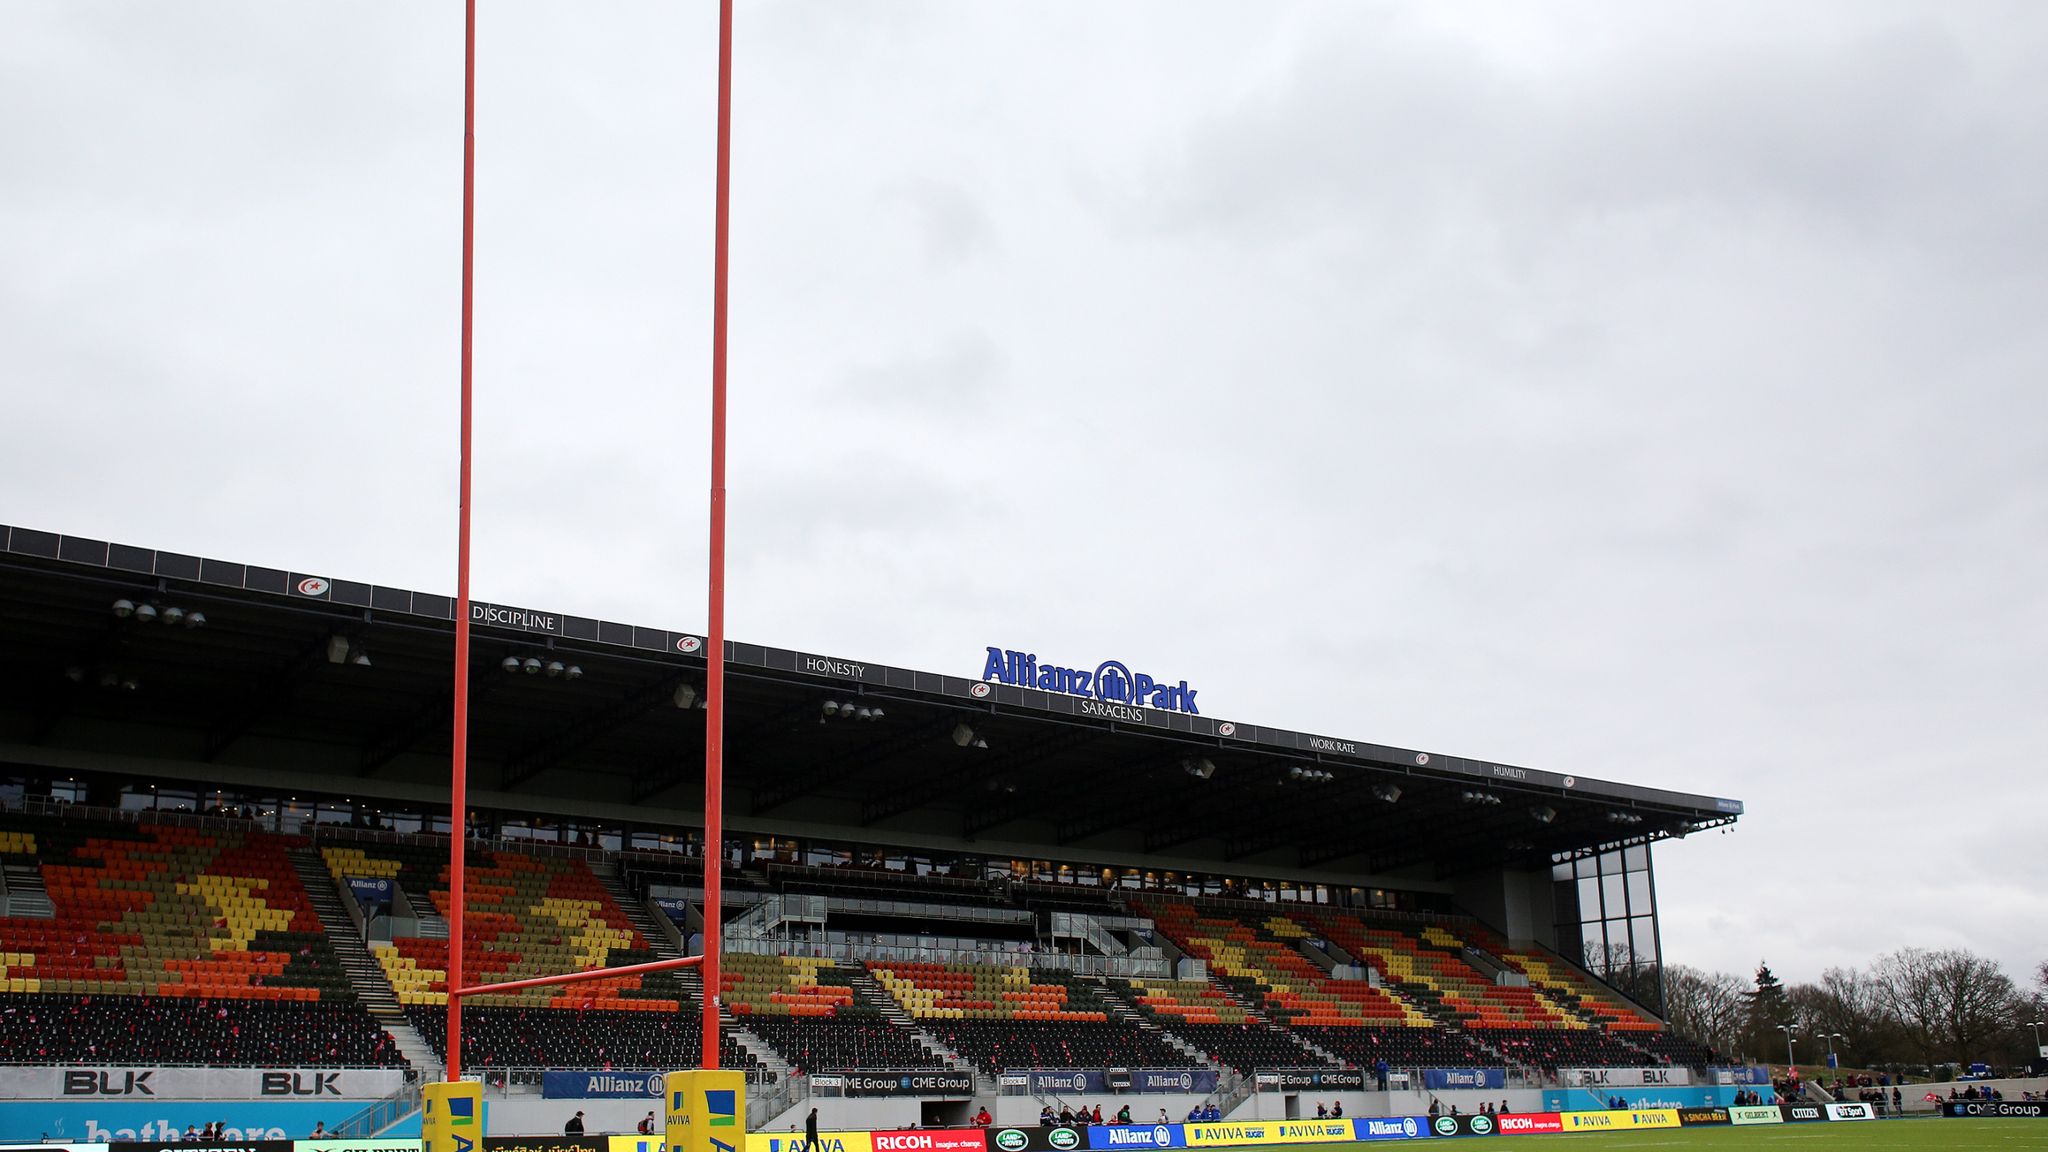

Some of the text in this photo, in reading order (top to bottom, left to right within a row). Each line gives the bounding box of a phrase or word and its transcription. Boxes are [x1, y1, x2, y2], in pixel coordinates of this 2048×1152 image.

[472, 606, 554, 630] DISCIPLINE
[806, 658, 864, 677] HONESTY
[982, 646, 1199, 714] Allianz Park
[1081, 700, 1142, 721] SARACENS
[1309, 737, 1355, 753] WORK RATE
[1493, 766, 1526, 779] HUMILITY
[351, 880, 376, 889] Allianz
[64, 1071, 154, 1095] BLK
[1037, 1076, 1072, 1088] Allianz
[1148, 1075, 1179, 1087] Allianz
[1287, 1075, 1311, 1086] Group
[1321, 1074, 1361, 1085] CME Group
[1446, 1073, 1474, 1084] Allianz
[1583, 1070, 1610, 1084] BLK
[1643, 1070, 1669, 1083] BLK
[261, 1072, 342, 1095] BLK
[587, 1076, 643, 1092] Allianz
[845, 1077, 897, 1091] ME Group
[912, 1077, 969, 1090] CME Group
[1792, 1107, 1819, 1119] CITIZEN
[1998, 1103, 2040, 1117] Group
[667, 1115, 690, 1125] AVIVA
[1500, 1118, 1533, 1129] RICOH
[1583, 1116, 1611, 1126] AVIVA
[1641, 1114, 1667, 1124] AVIVA
[1205, 1127, 1243, 1140] AVIVA
[1289, 1125, 1324, 1137] AVIVA
[1368, 1121, 1403, 1135] Allianz
[876, 1135, 932, 1150] RICOH
[1109, 1128, 1153, 1144] Allianz
[789, 1139, 845, 1152] AVVA
